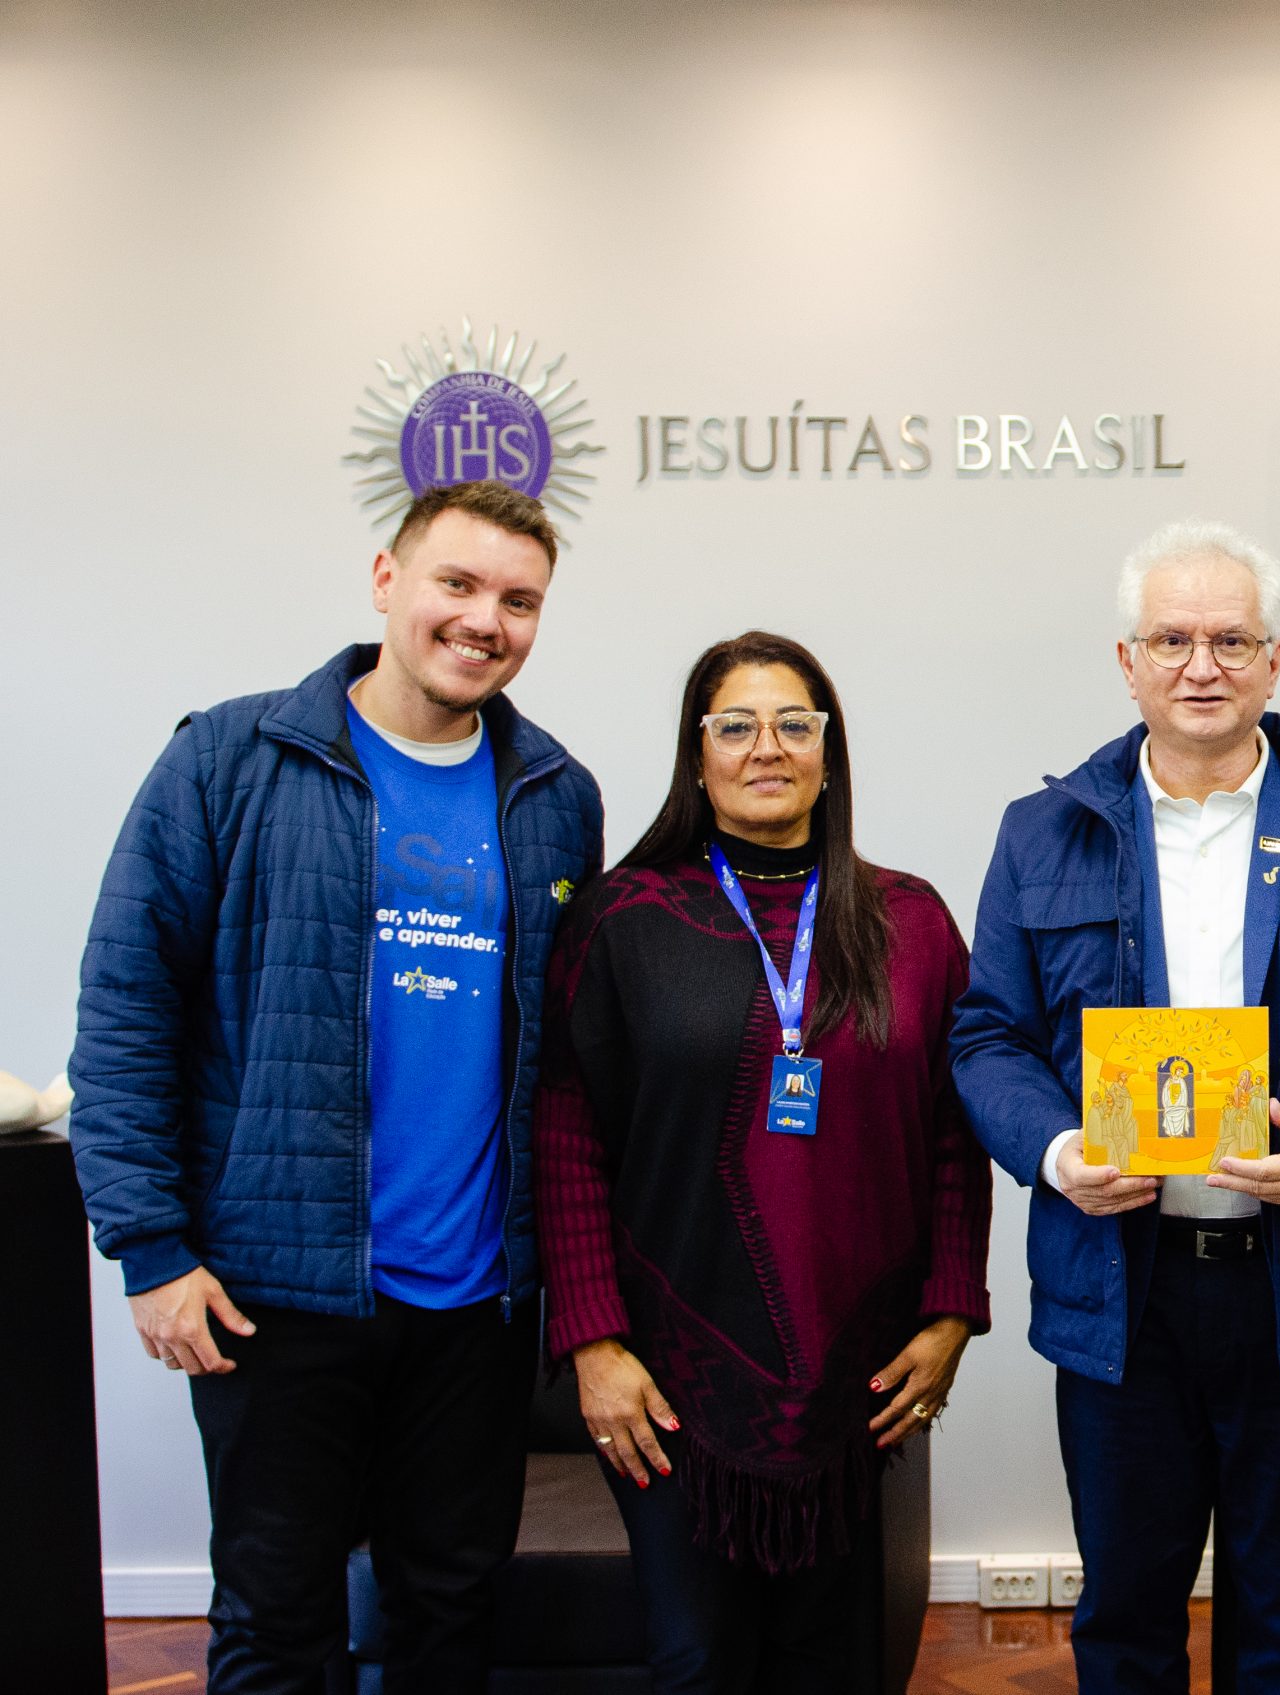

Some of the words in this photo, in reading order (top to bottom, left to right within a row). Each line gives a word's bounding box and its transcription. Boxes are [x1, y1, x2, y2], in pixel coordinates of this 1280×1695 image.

[411, 374, 486, 419] COMPANHIA
[487, 375, 507, 393] DE
[432, 423, 529, 482] IHS
[637, 400, 932, 483] JESUÍTAS
[956, 413, 1186, 471] BRASIL
[407, 907, 462, 929] viver
[379, 927, 394, 942] e
[397, 928, 499, 953] aprender.
[393, 972, 410, 987] La
[426, 975, 458, 991] Salle
